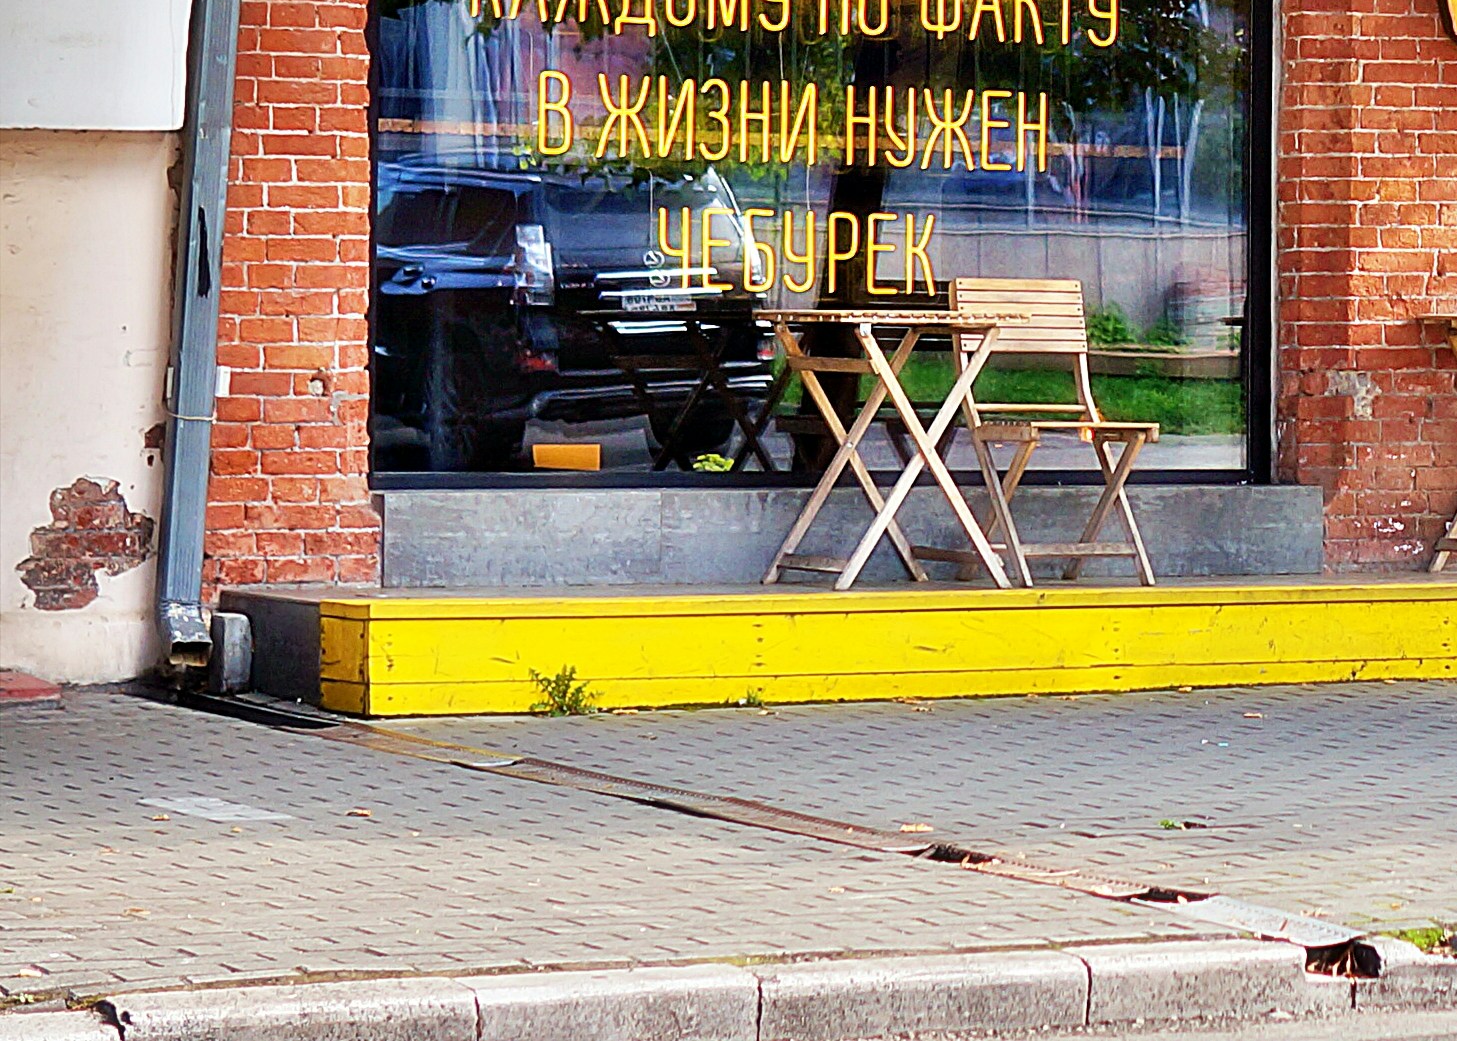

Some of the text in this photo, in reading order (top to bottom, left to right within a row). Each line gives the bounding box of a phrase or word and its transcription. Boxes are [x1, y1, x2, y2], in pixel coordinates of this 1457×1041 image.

[536, 69, 1049, 174] В ЖИЗНИ НУЖЕН
[657, 206, 937, 296] ЧЕБУРЕК
